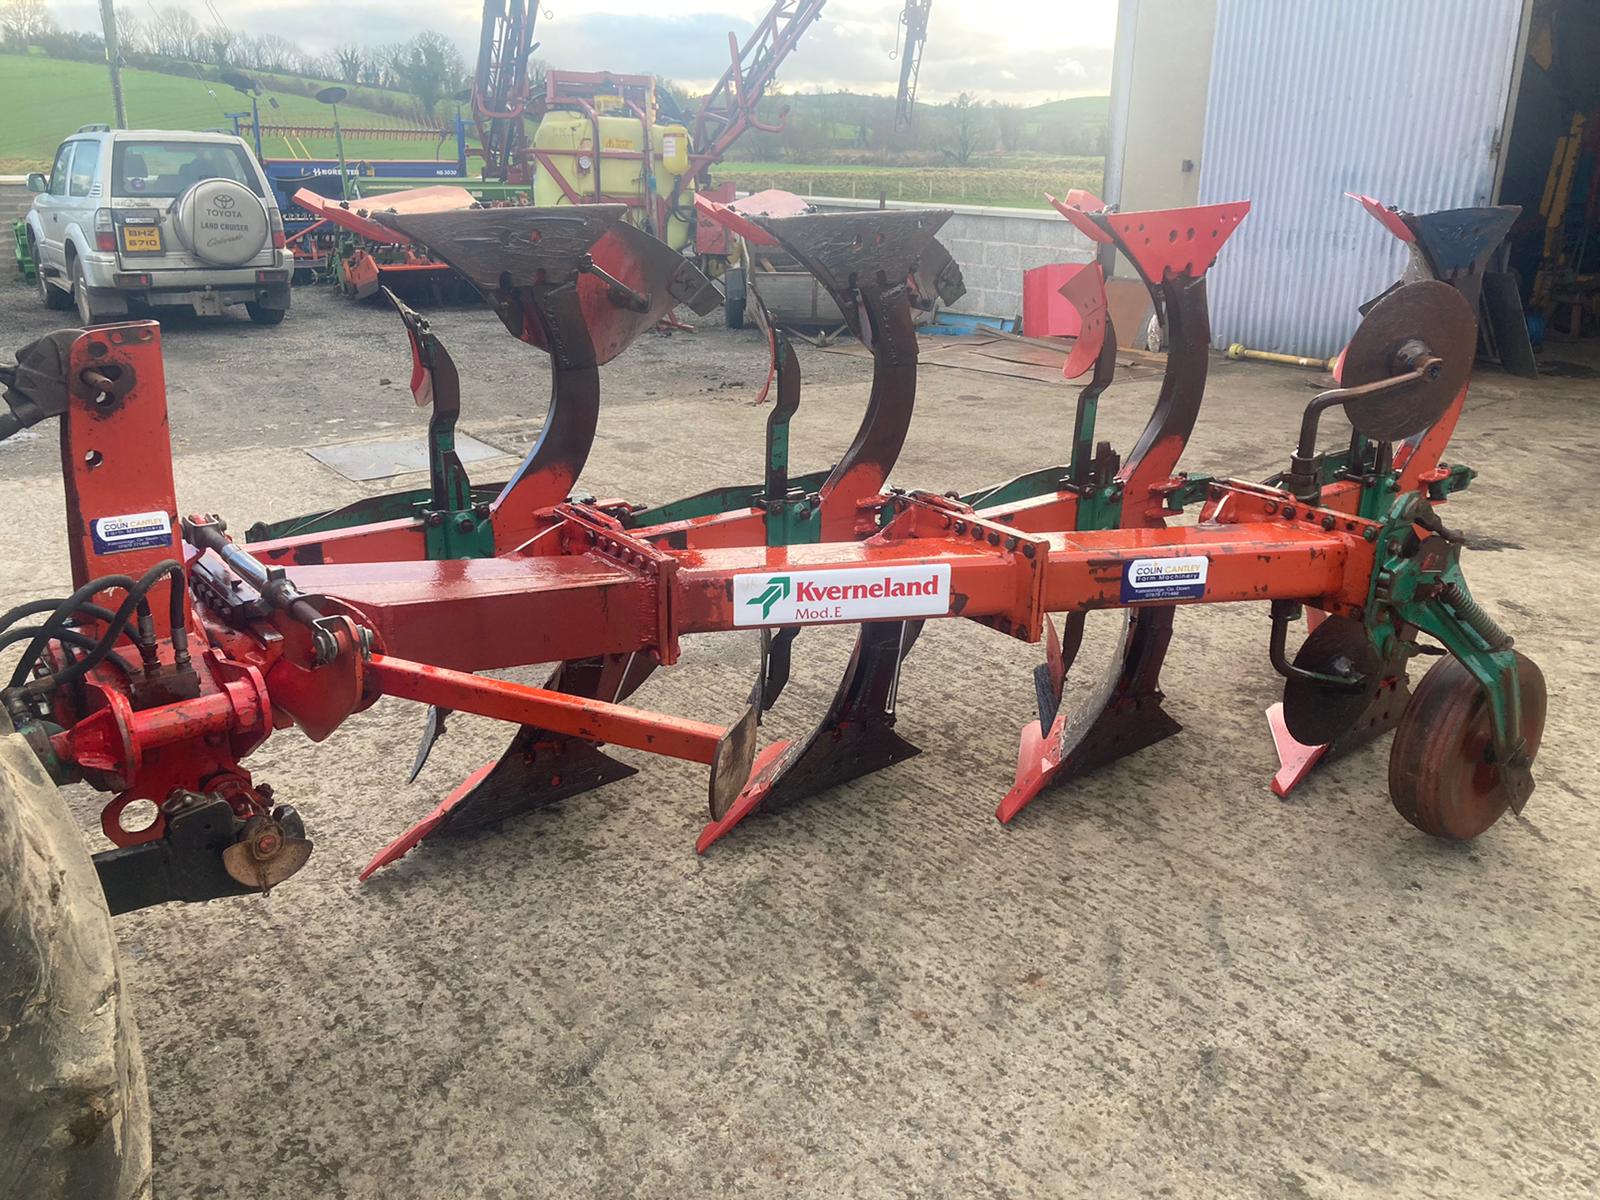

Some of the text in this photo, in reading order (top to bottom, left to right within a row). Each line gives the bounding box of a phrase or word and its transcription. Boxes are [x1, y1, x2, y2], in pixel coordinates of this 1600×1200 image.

[206, 208, 242, 218] TOYOTA
[200, 222, 249, 232] LAND CRUISER
[128, 228, 156, 237] BHZ
[129, 239, 157, 247] 6710
[104, 522, 128, 531] COLIN
[1136, 564, 1200, 575] COLIN CANTLEY
[1158, 573, 1197, 581] Machinery
[796, 574, 939, 602] Kverneland
[795, 606, 843, 620] Mod.E
